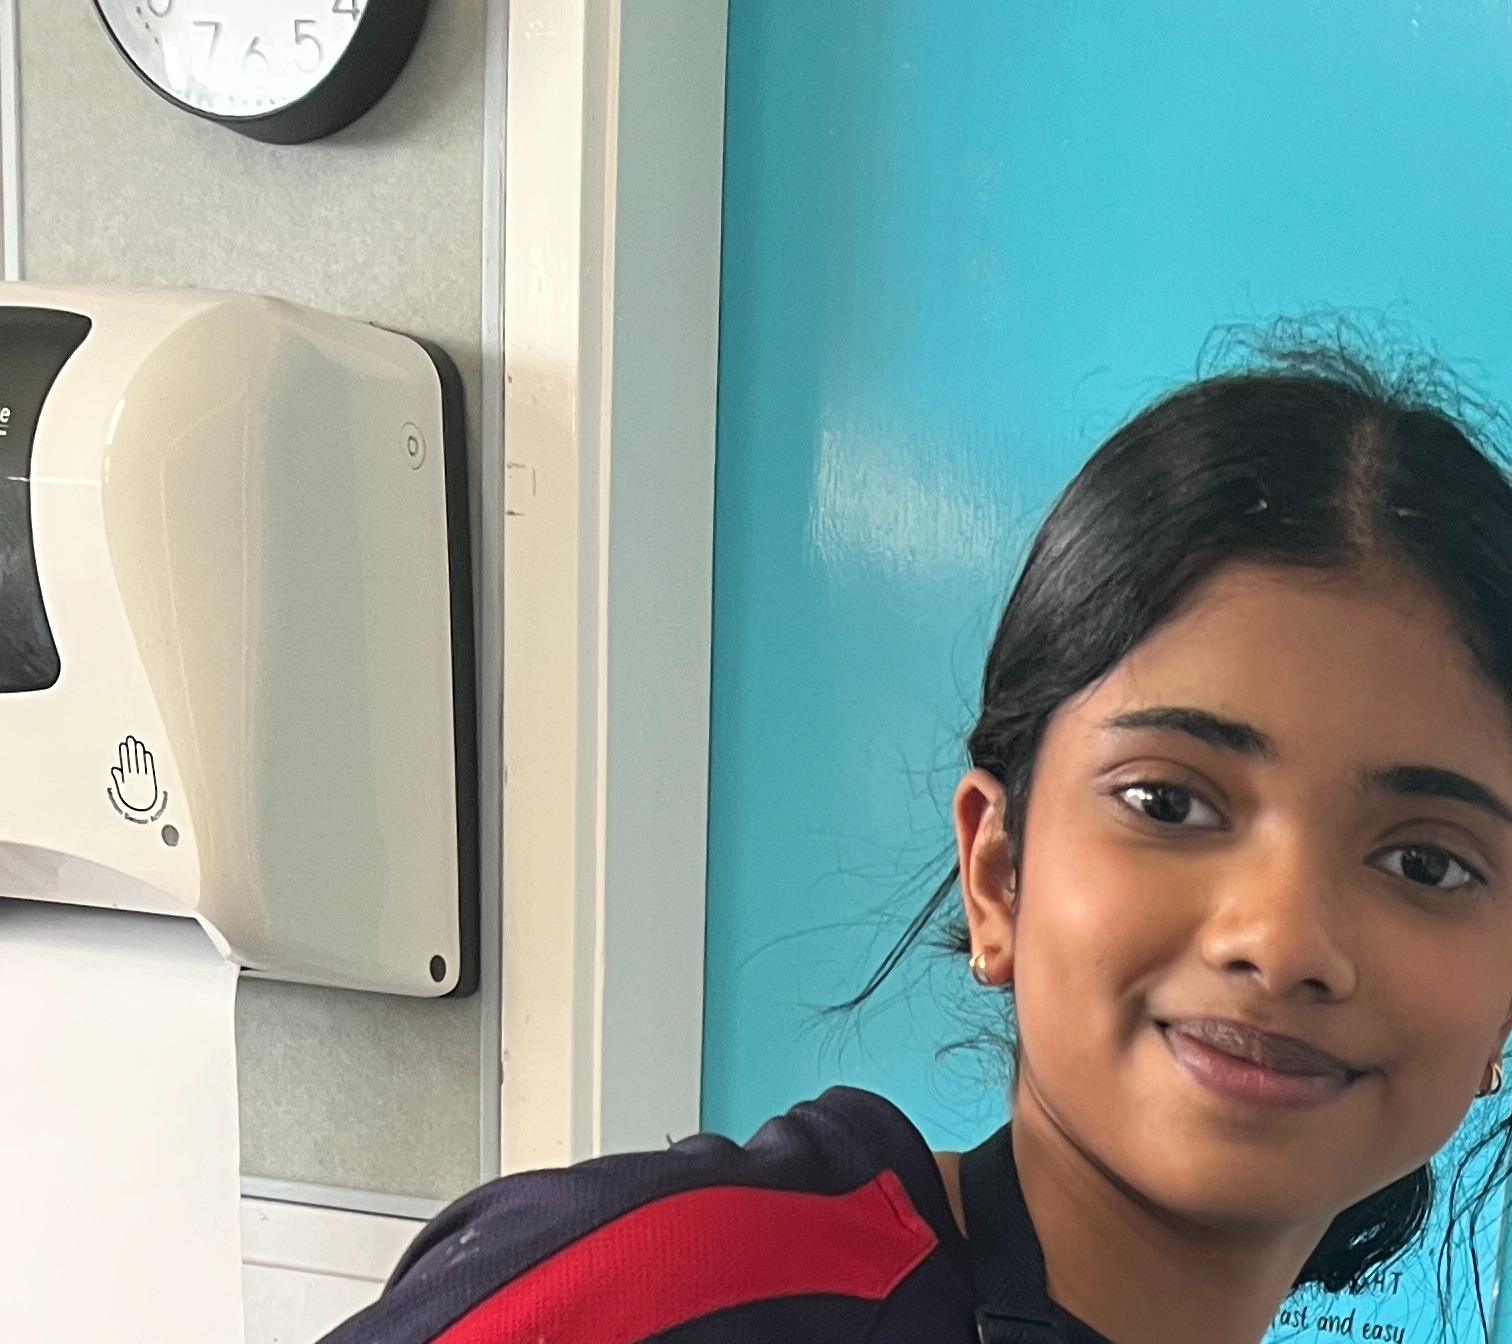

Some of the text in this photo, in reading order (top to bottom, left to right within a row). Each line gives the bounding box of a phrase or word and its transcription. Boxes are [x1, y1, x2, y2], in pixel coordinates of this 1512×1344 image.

[193, 20, 222, 68] 7
[294, 19, 324, 74] 5
[1271, 1305, 1309, 1330] ast
[1317, 1307, 1356, 1336] and
